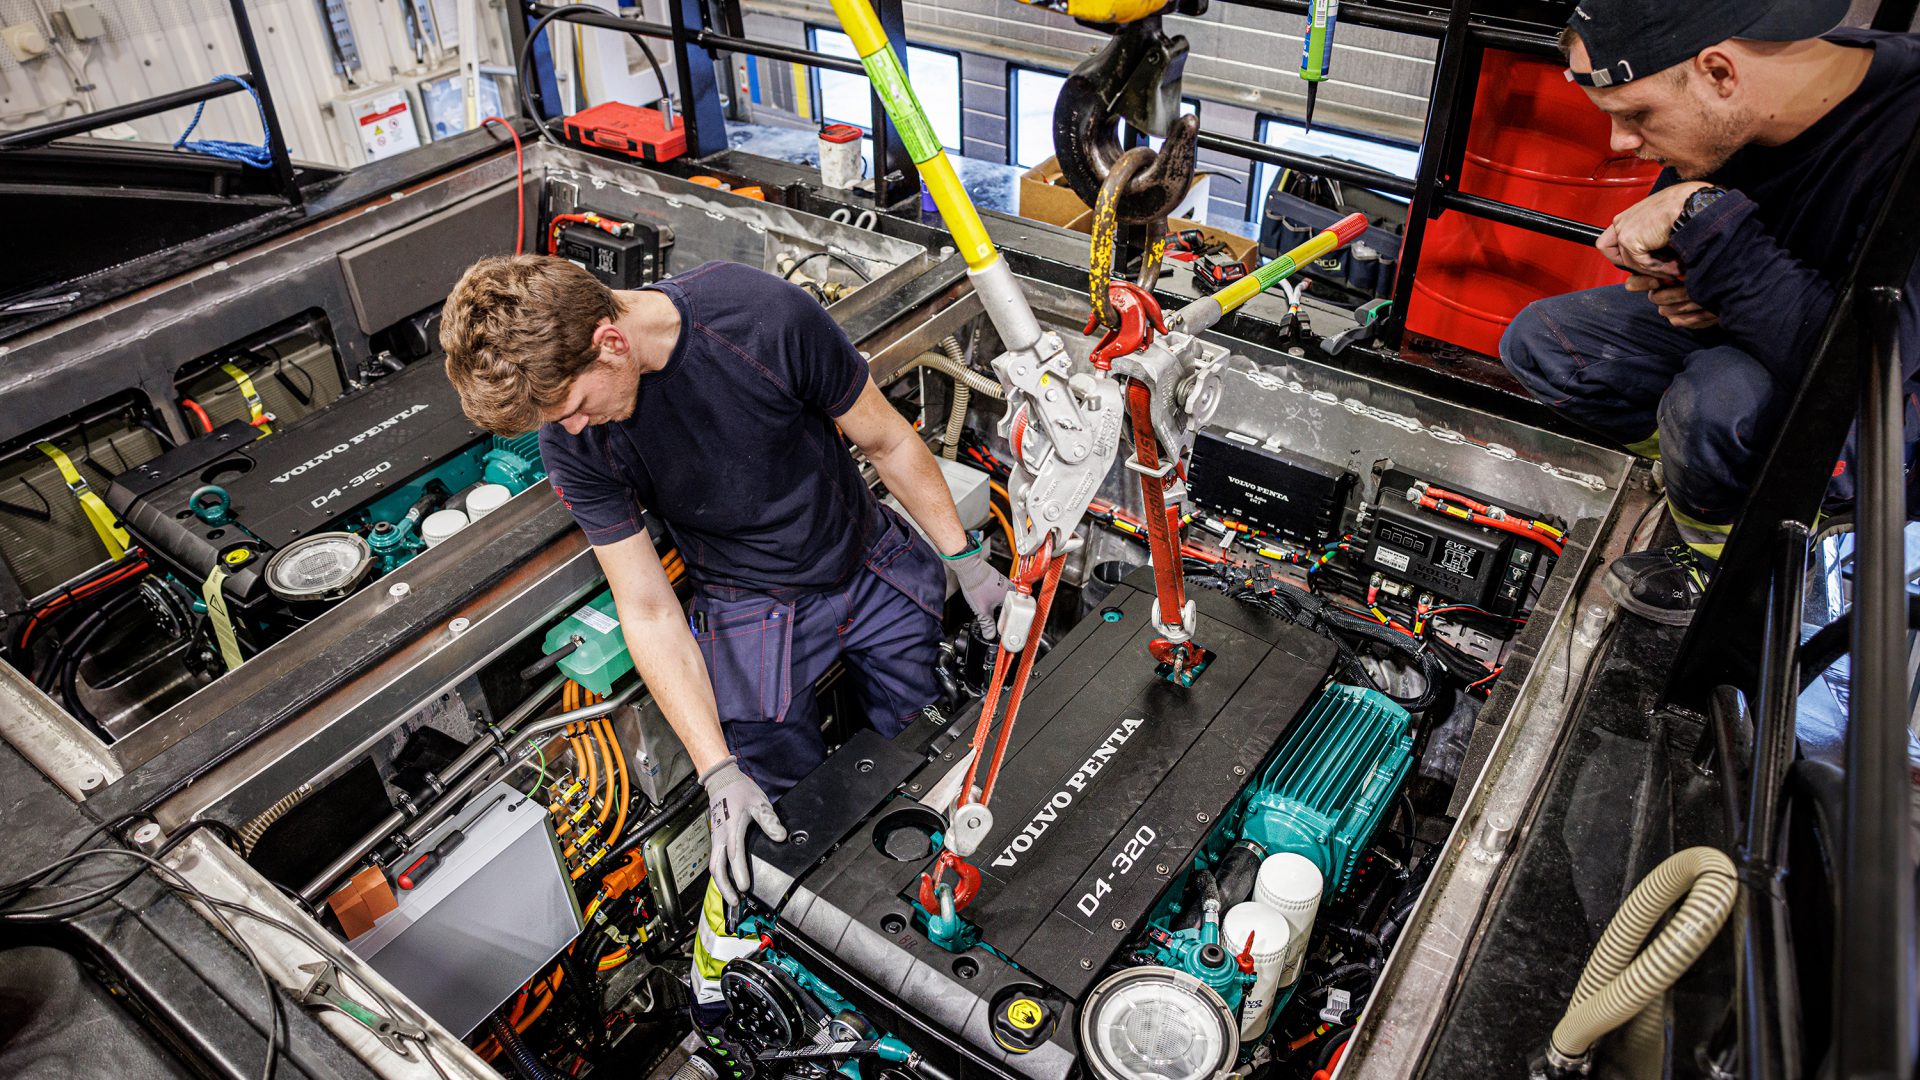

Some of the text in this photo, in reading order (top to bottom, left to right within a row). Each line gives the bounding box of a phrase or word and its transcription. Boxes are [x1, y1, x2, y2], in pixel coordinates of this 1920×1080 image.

[270, 404, 429, 483] VOLVO PENTA
[310, 461, 392, 509] D4-320
[1227, 475, 1290, 502] VOLVO PENTA
[1445, 540, 1467, 551] EVC
[1413, 569, 1460, 591] PENTA
[1416, 563, 1462, 585] VOLVO
[990, 718, 1145, 868] VOLVO PENTA
[1076, 825, 1156, 918] D4-320
